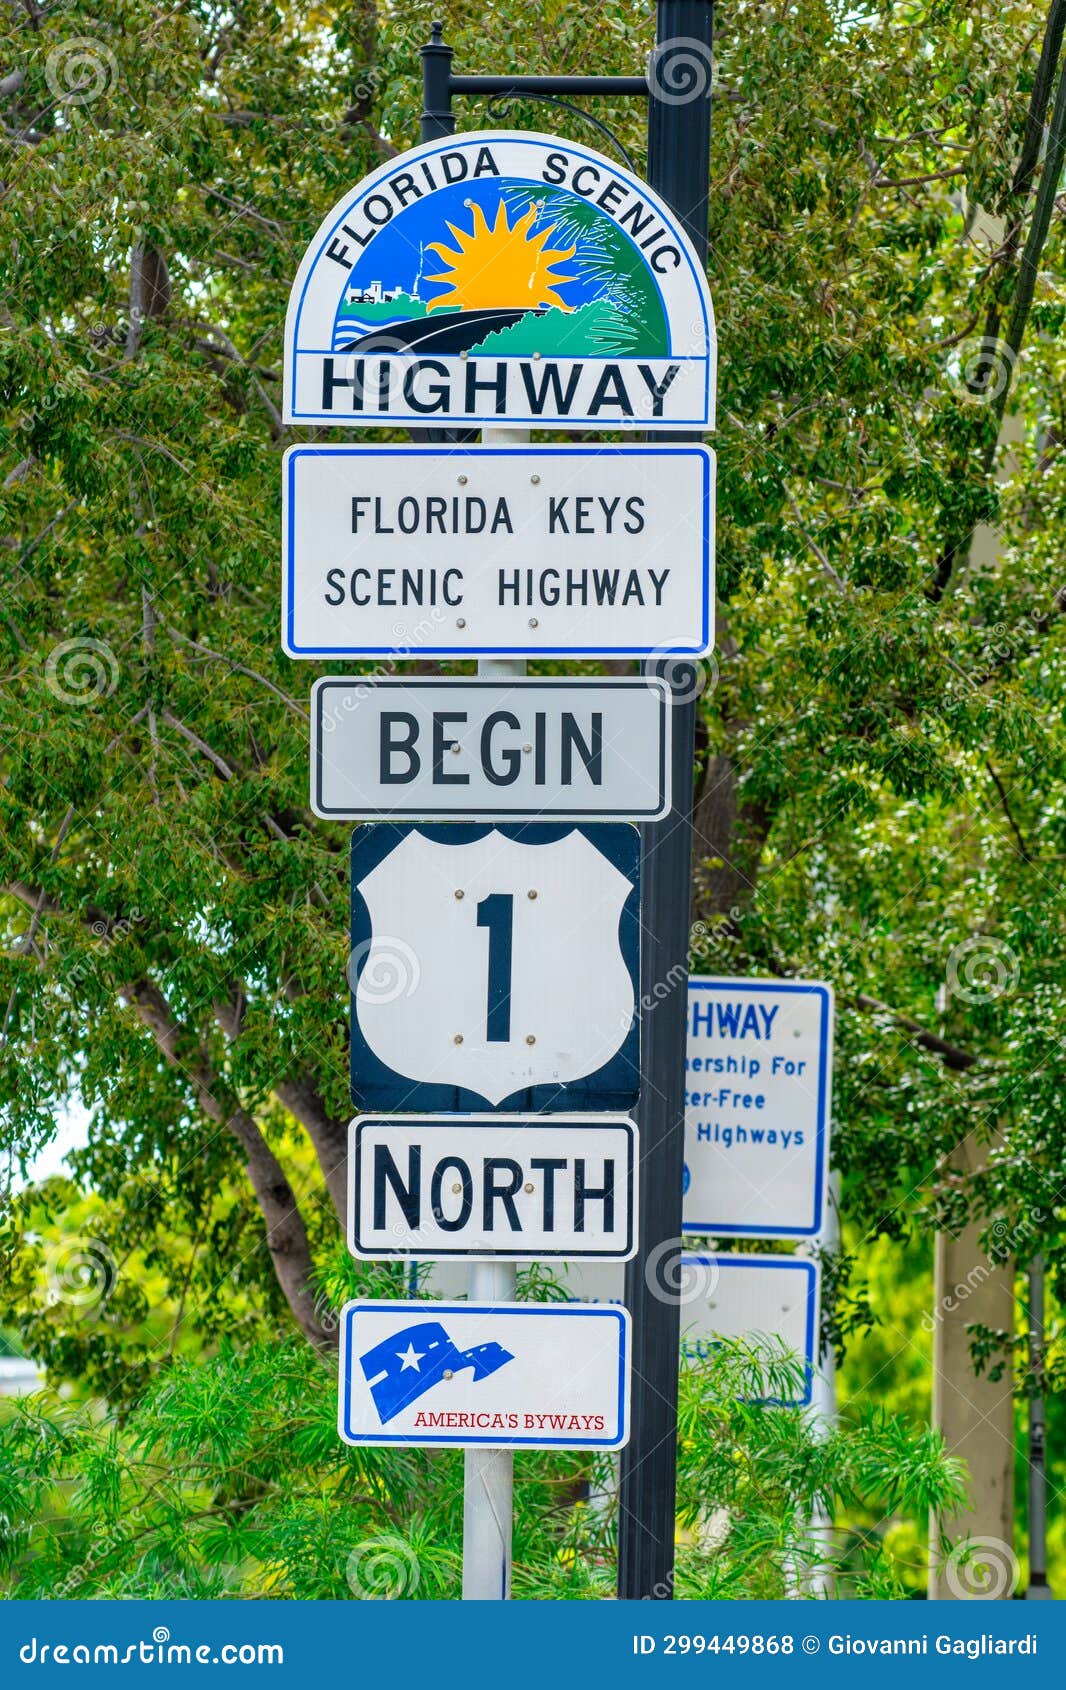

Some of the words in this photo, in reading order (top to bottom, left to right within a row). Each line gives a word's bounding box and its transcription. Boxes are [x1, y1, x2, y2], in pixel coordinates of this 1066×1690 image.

[326, 147, 500, 270] FLORIDA
[542, 152, 681, 275] SCENIC
[322, 358, 683, 417] HIGHWAY
[351, 497, 513, 534] FLORIDA
[549, 497, 645, 534] KEYS
[324, 568, 464, 606] SCENIC
[499, 568, 671, 606] HIGHWAY
[380, 711, 602, 786] BEGIN
[477, 893, 513, 1042] 1
[687, 1001, 779, 1040] HWAY
[685, 1055, 761, 1079] ership
[772, 1056, 806, 1076] For
[697, 1122, 804, 1149] Highways
[373, 1144, 615, 1232] NORTH
[414, 1412, 518, 1429] AMERICA'S
[524, 1414, 605, 1431] BYWAYS
